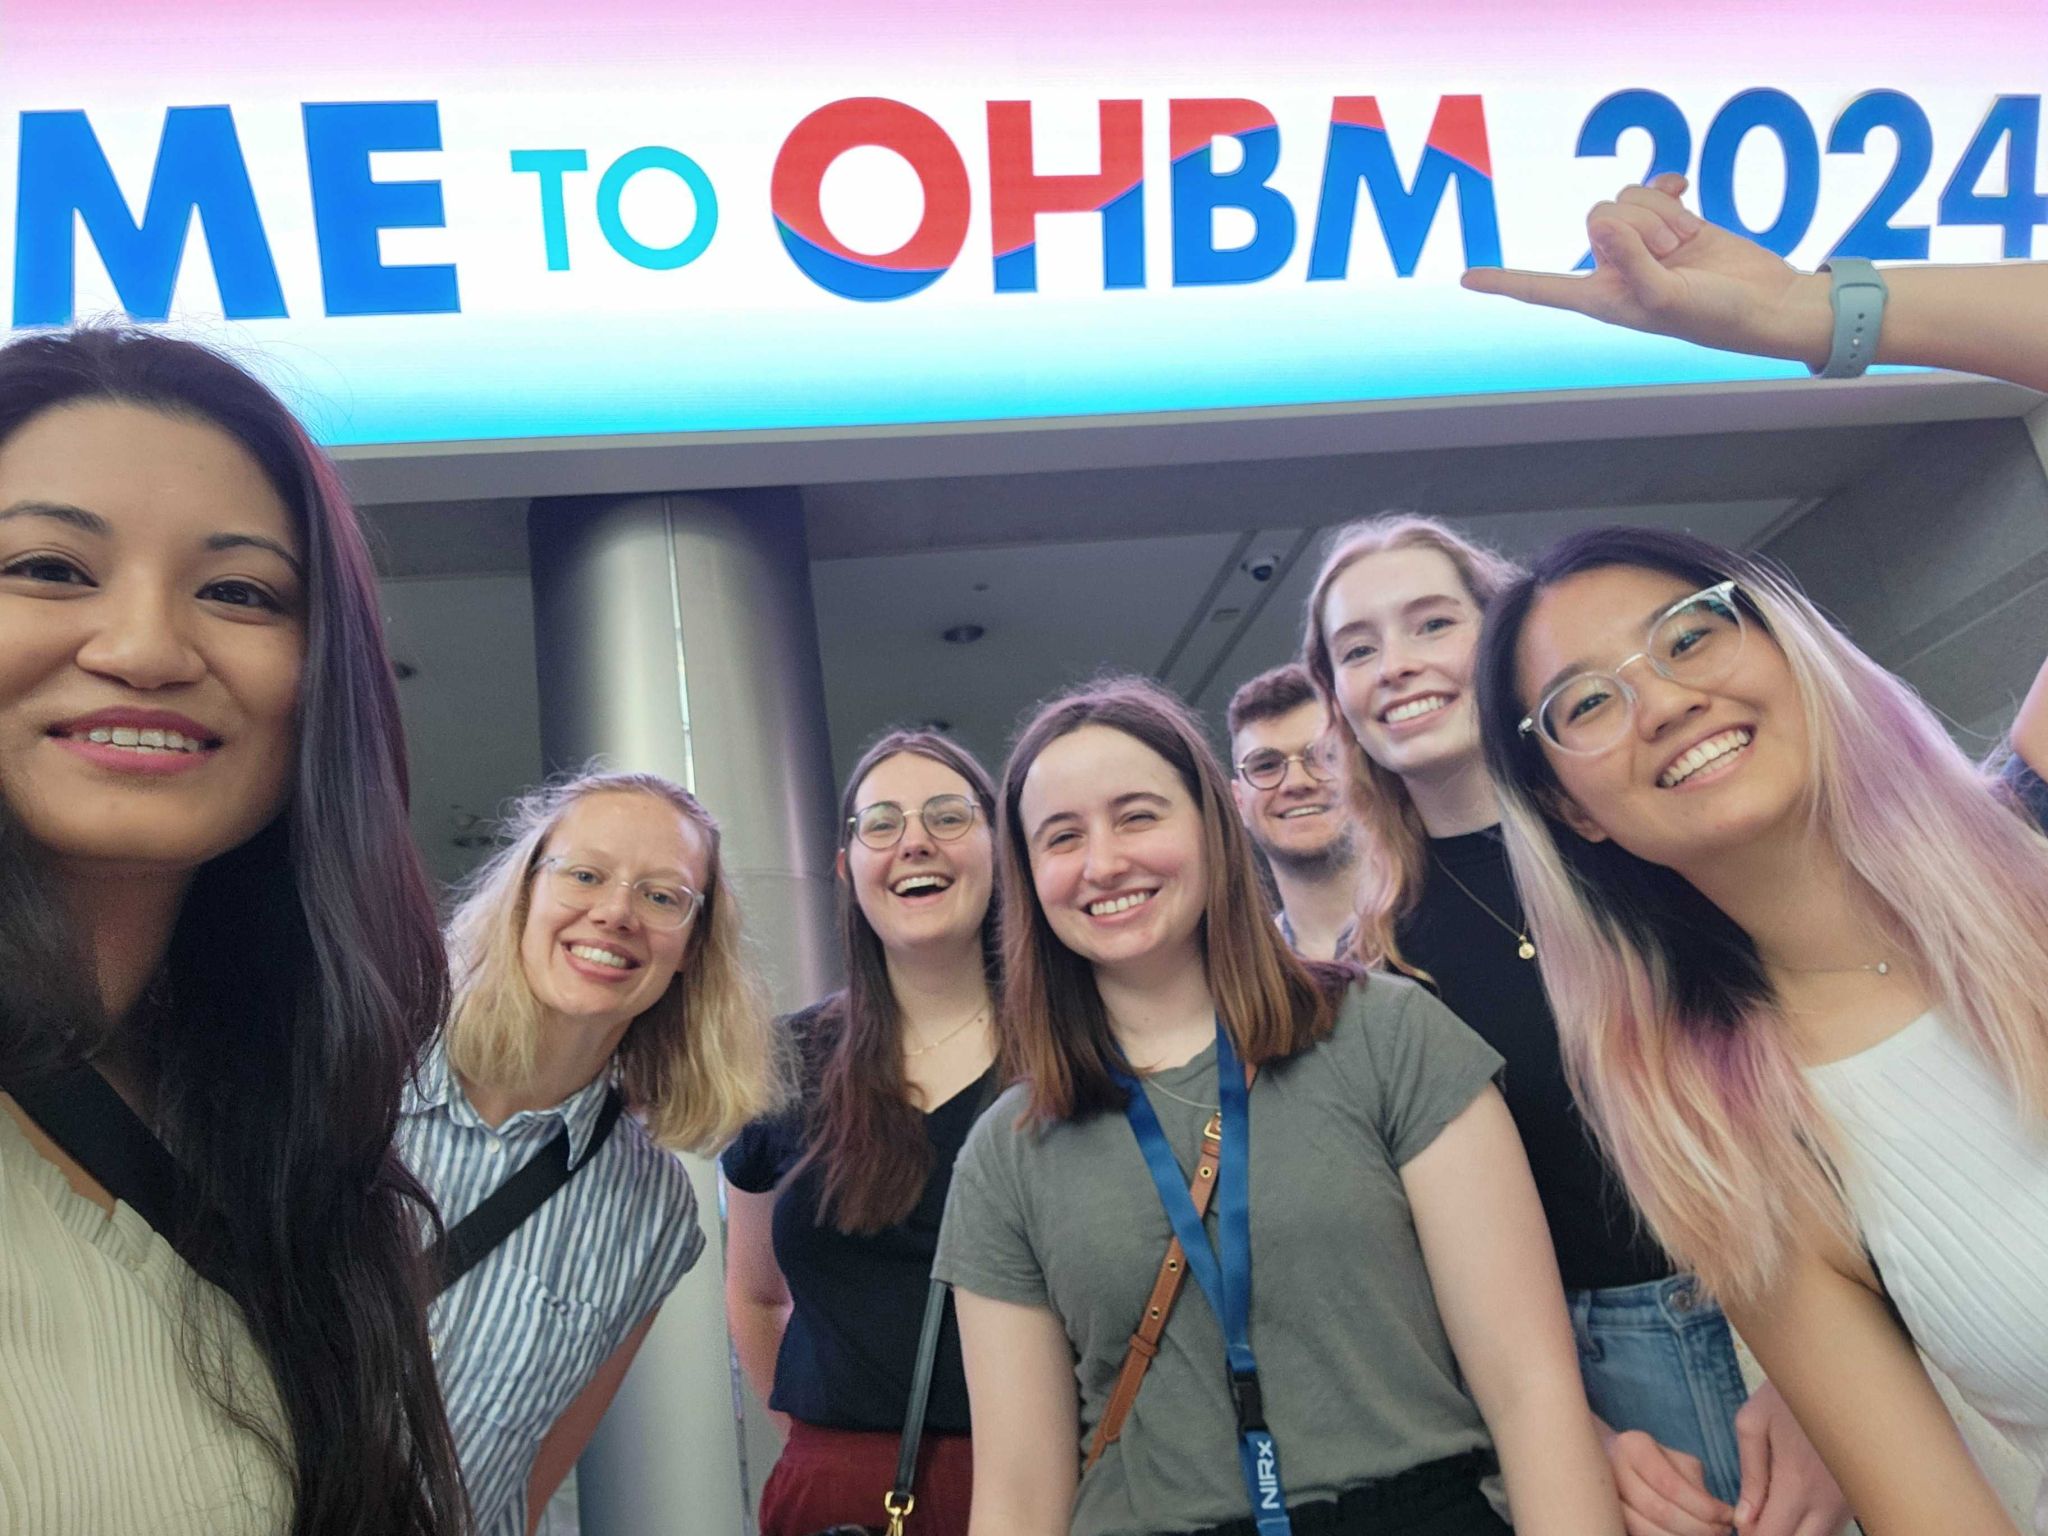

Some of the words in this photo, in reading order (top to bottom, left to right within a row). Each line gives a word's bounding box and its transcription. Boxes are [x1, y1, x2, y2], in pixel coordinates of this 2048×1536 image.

[11, 101, 461, 329] ME
[510, 145, 719, 271] TO
[770, 95, 1503, 302] OHBM
